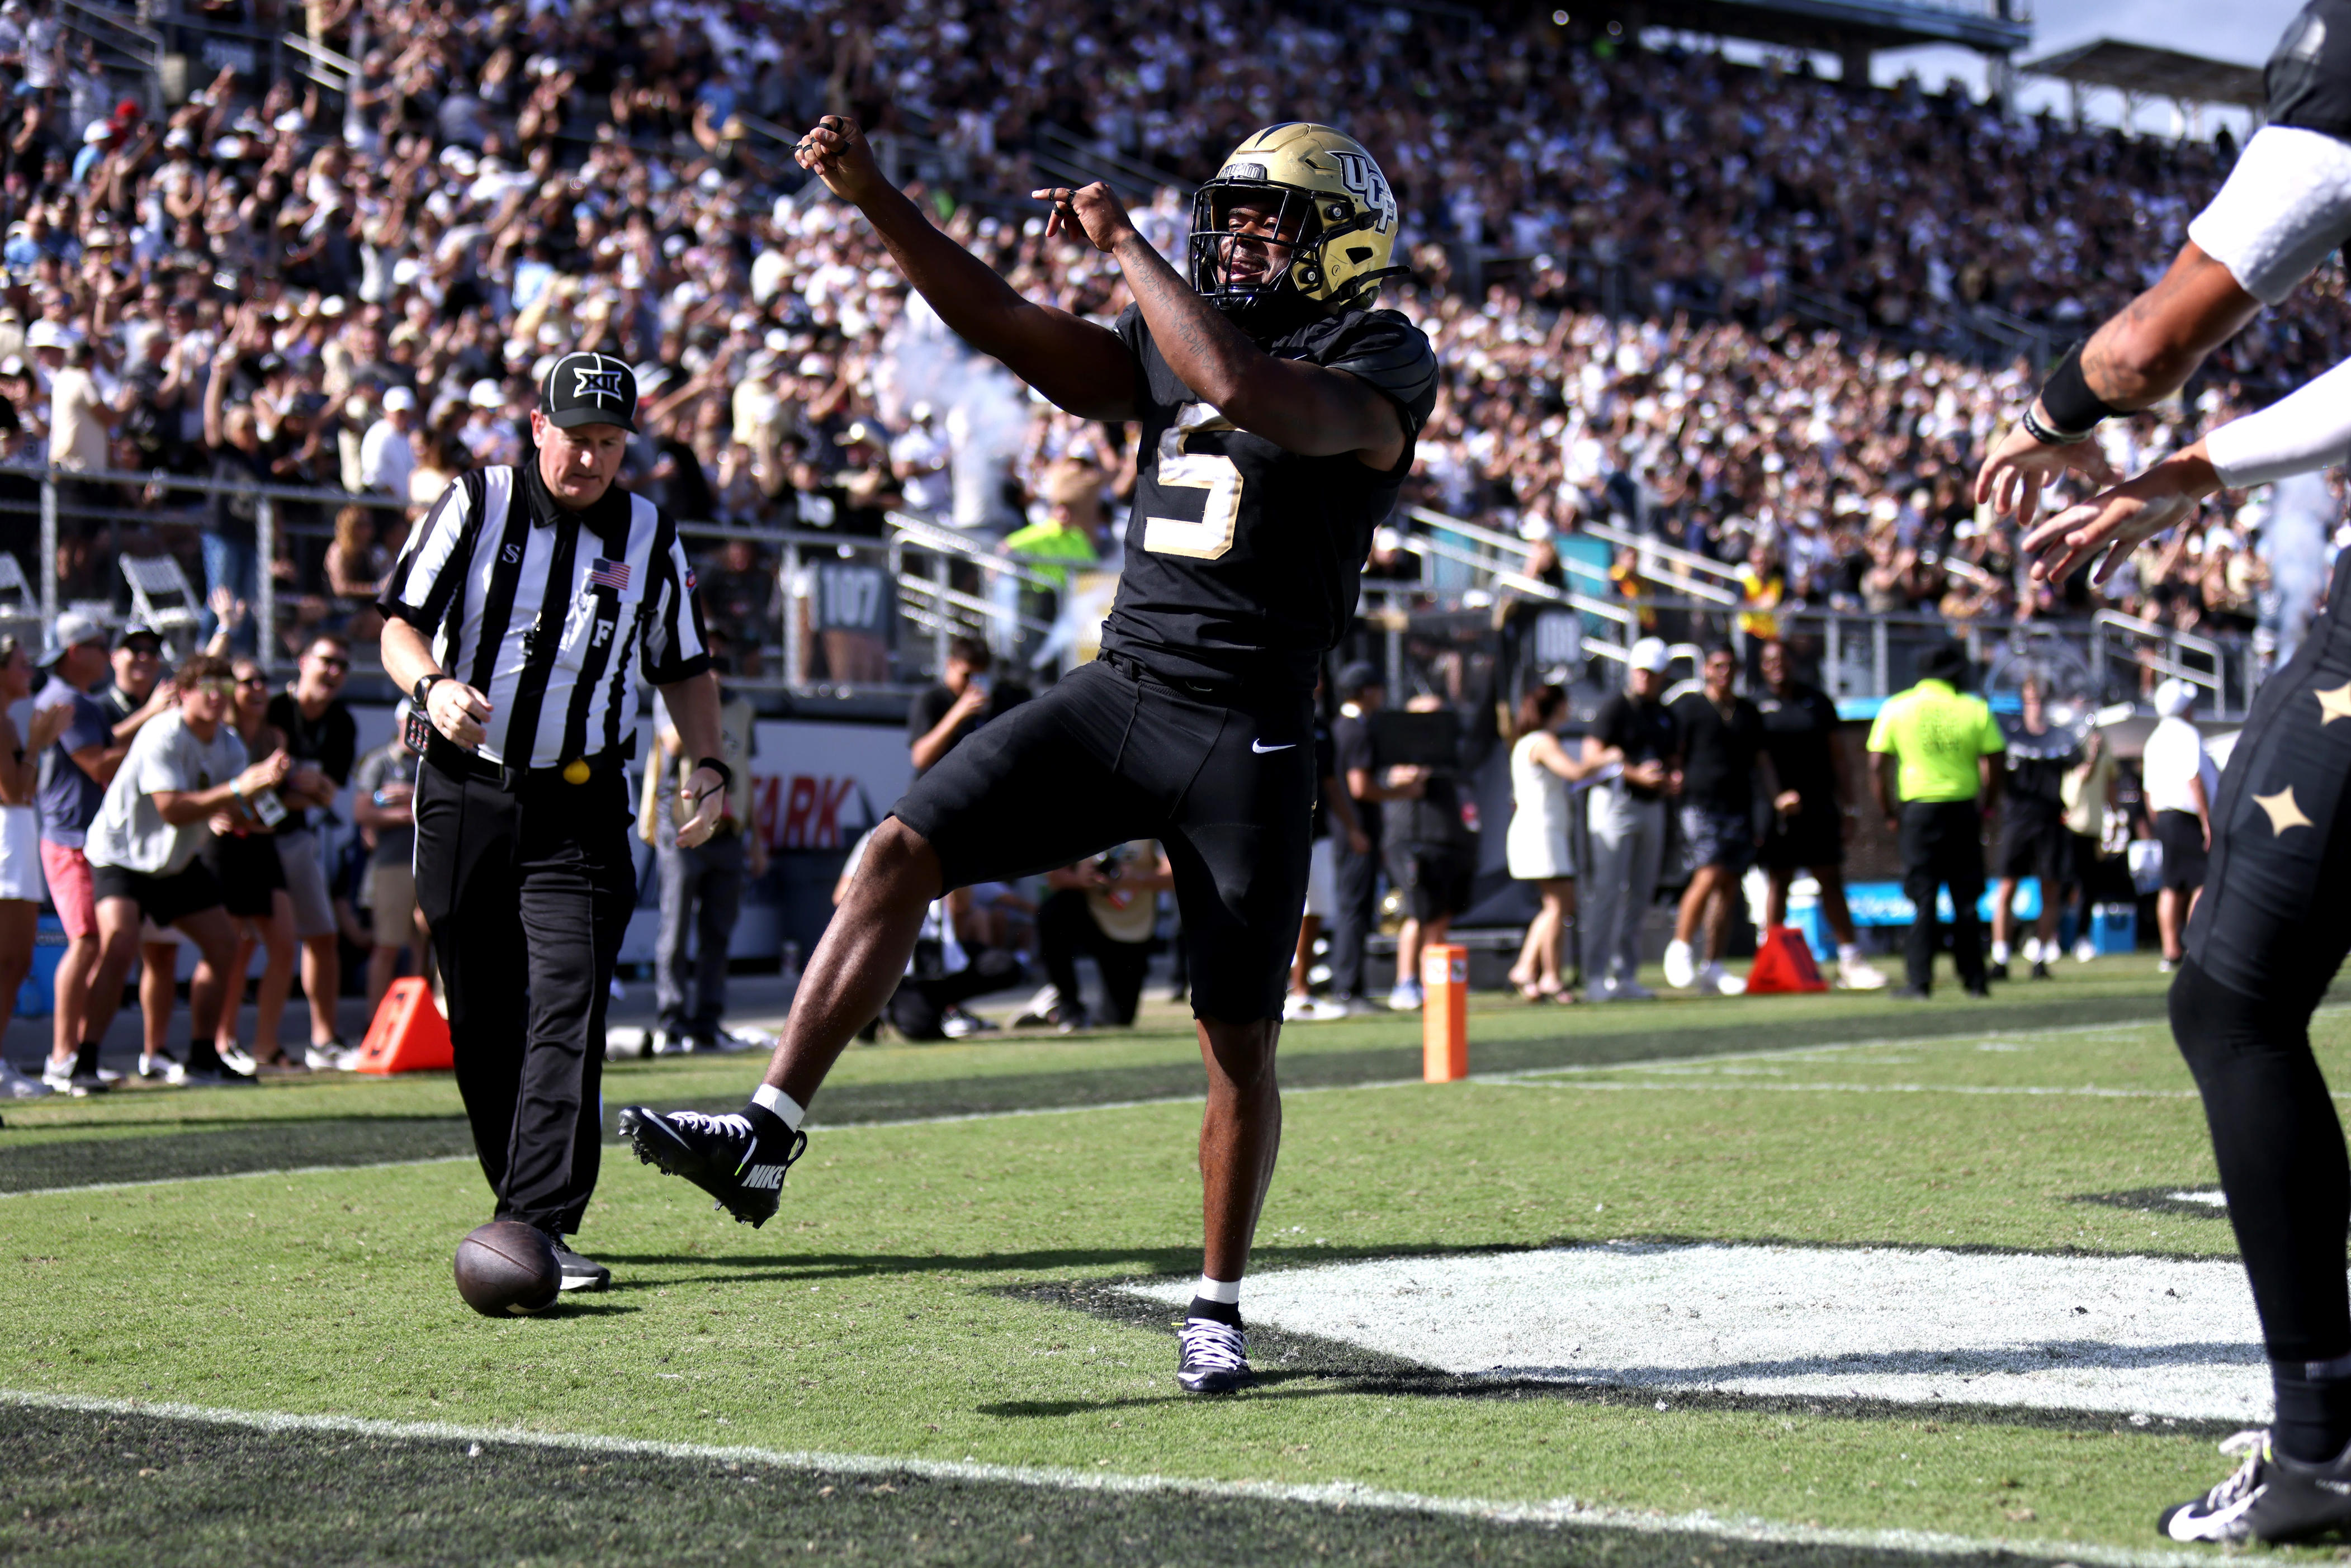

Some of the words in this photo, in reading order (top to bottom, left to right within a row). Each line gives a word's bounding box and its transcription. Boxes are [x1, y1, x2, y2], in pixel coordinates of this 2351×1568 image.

[1336, 151, 1396, 235] UCF
[575, 369, 623, 399] XII
[1144, 402, 1248, 560] 5
[502, 543, 521, 563] S
[822, 566, 882, 627] 107
[592, 618, 614, 648] F
[751, 775, 855, 846] ARK
[741, 1164, 787, 1189] NIKE
